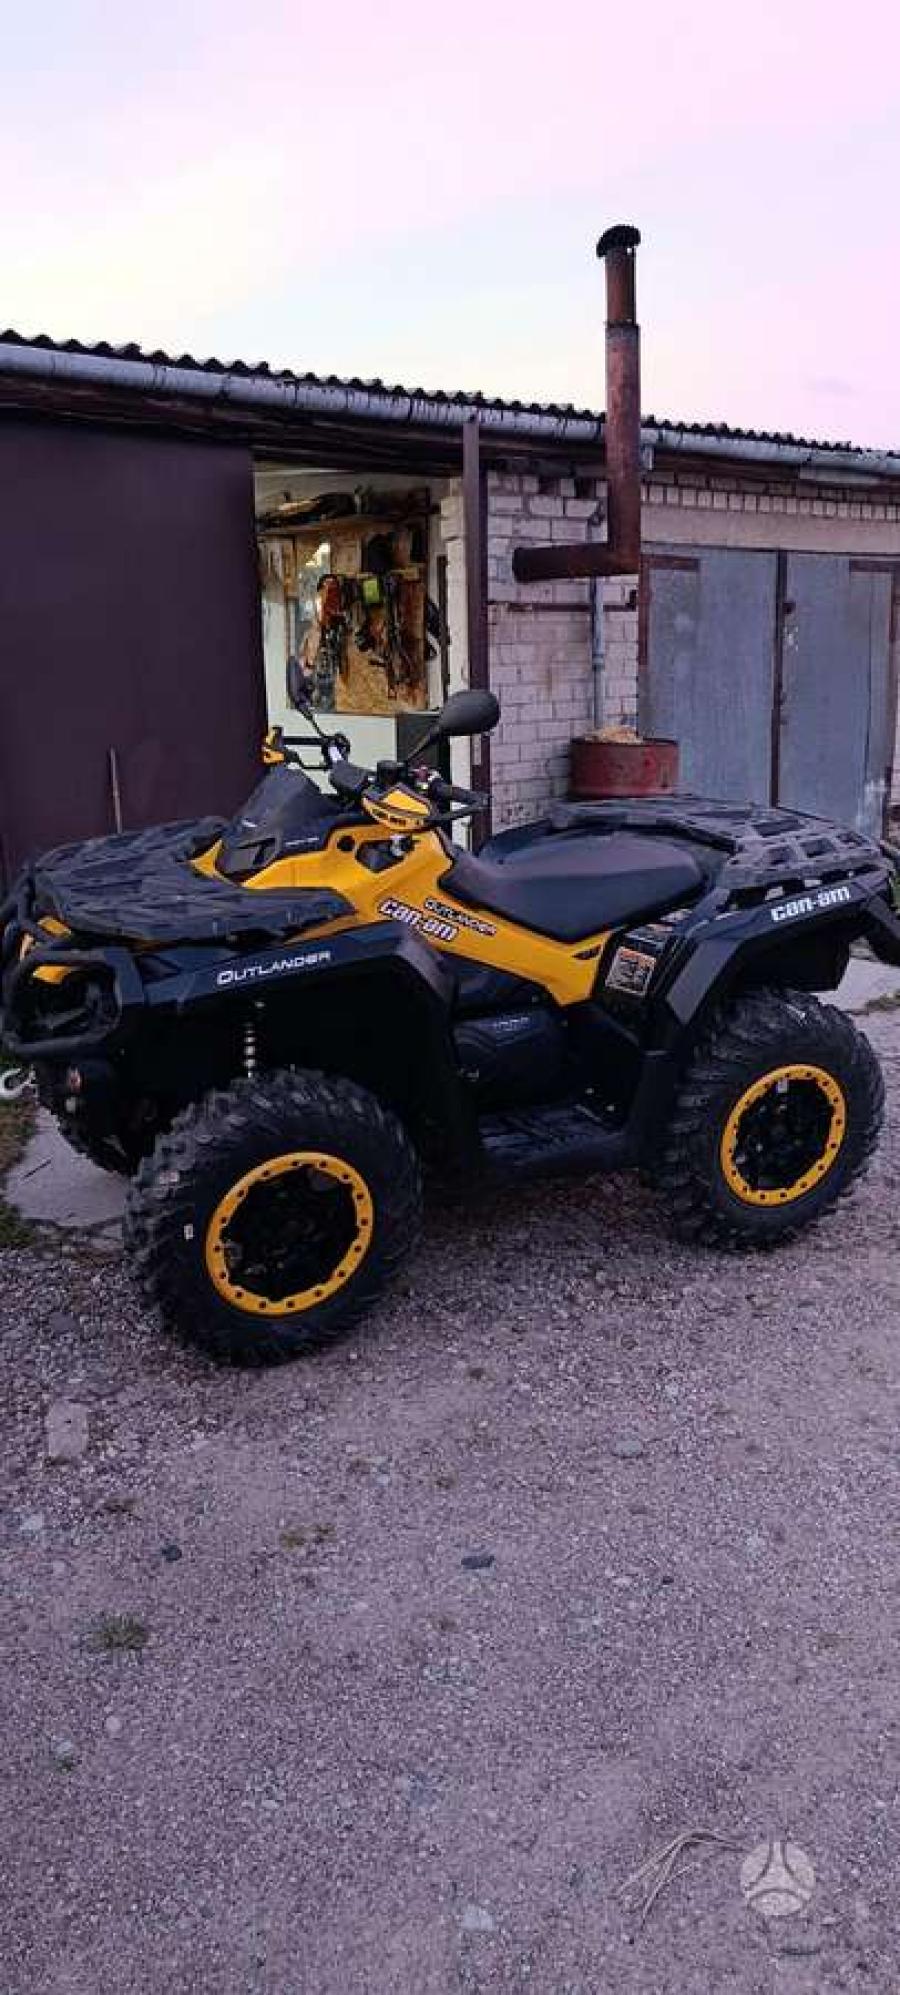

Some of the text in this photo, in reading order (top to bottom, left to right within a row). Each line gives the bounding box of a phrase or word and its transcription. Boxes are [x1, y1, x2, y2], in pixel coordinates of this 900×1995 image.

[378, 898, 459, 942] can-am
[424, 896, 497, 936] OUTLANDER
[770, 885, 851, 922] can-am
[217, 951, 331, 985] OUTLANDER
